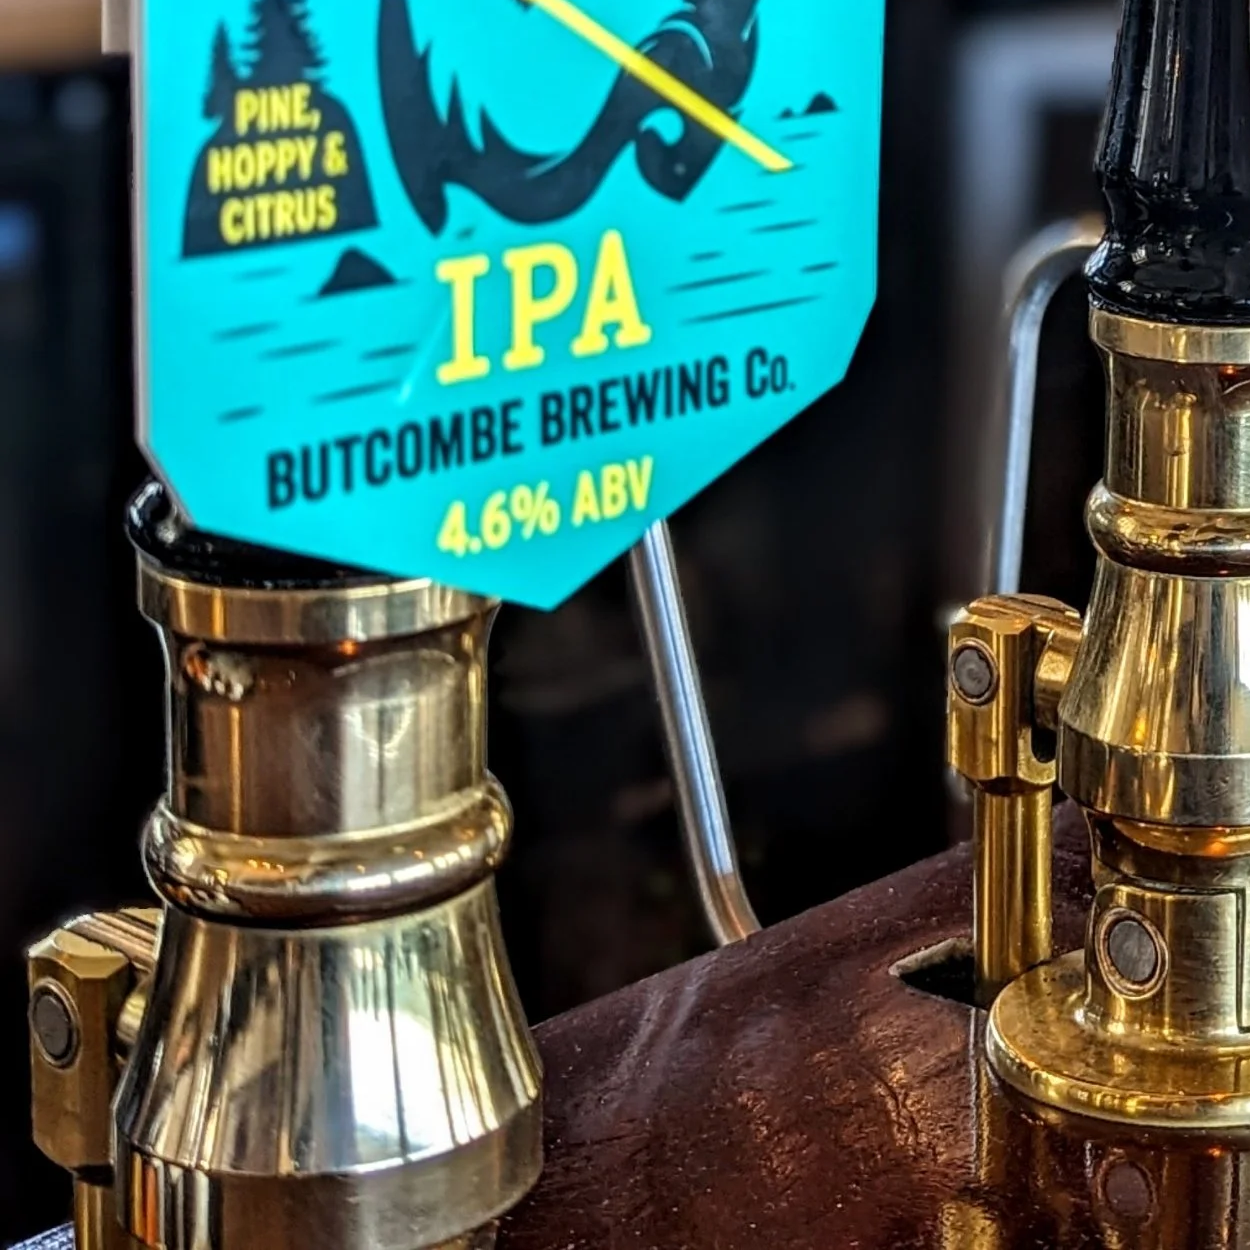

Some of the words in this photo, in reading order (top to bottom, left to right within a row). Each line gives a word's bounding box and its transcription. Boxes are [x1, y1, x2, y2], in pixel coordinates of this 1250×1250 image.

[235, 82, 321, 137] PINE,
[208, 135, 317, 194] HOPPY
[325, 131, 348, 176] &
[220, 184, 337, 246] CITRUS
[436, 229, 651, 385] IPA
[265, 399, 524, 510] BUTCOMBE
[539, 369, 731, 450] BREWING
[744, 347, 797, 400] Co.
[437, 486, 562, 558] 4.6%
[572, 456, 654, 527] ABV
